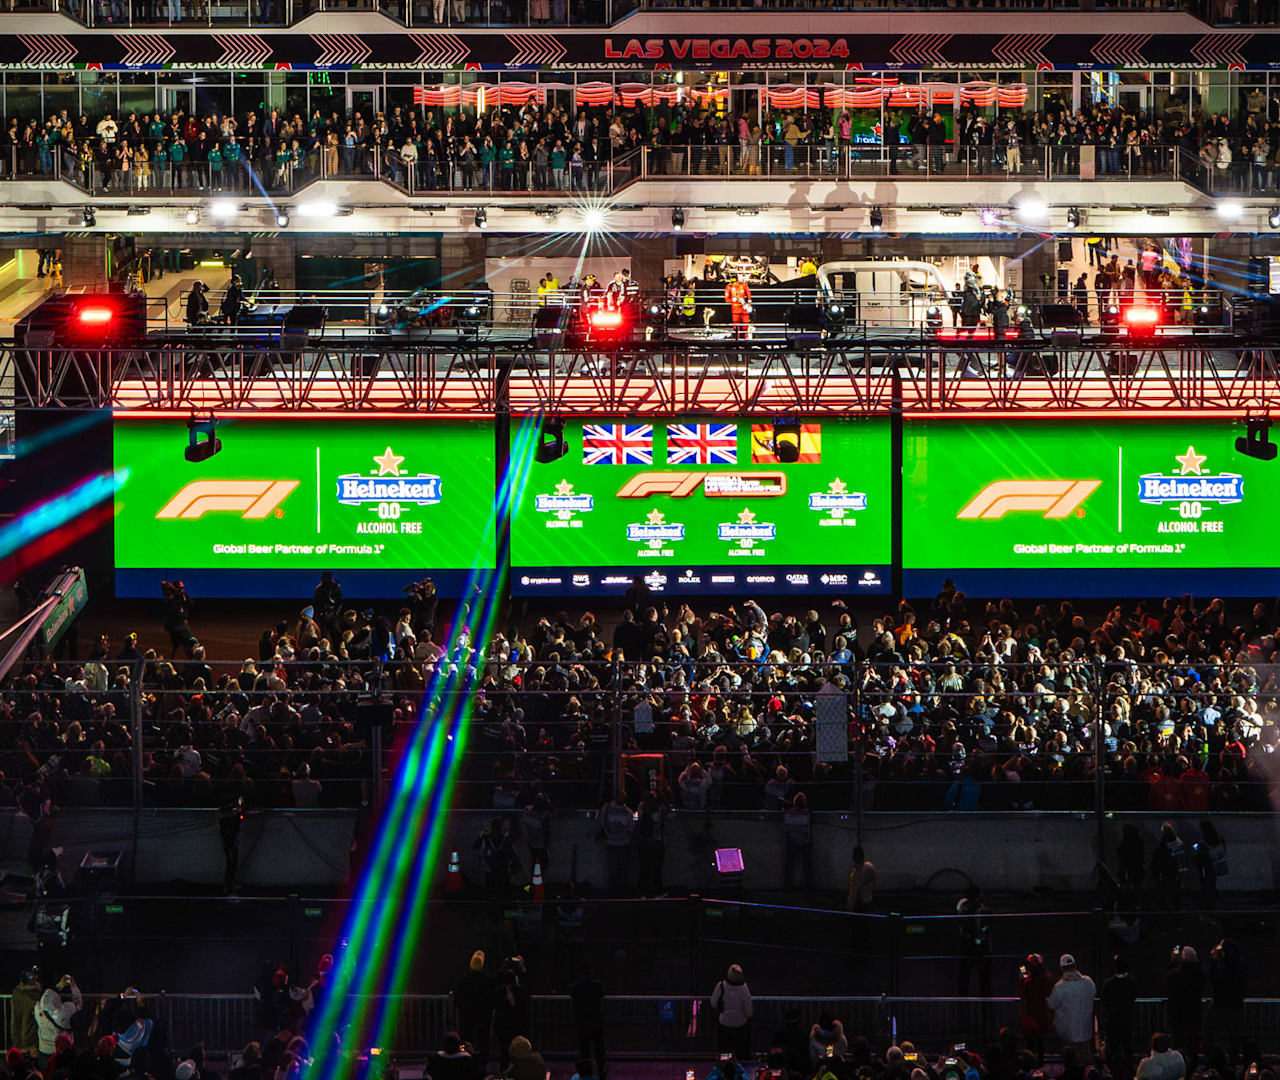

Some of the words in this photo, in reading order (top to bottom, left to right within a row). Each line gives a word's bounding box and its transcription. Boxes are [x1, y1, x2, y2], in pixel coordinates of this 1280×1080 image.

[605, 39, 664, 58] LAS
[669, 39, 772, 58] VEGAS
[775, 39, 850, 58] 2024
[155, 480, 301, 519] F1
[956, 479, 1102, 518] F1
[378, 503, 401, 519] 0.0
[1179, 502, 1202, 518] 0.0
[357, 522, 398, 534] ALCOHOL
[400, 522, 423, 534] FREE
[1158, 521, 1199, 533] ALCOHOL
[1201, 521, 1224, 533] FREE
[213, 544, 246, 554] Global
[248, 544, 273, 554] Beer
[275, 544, 313, 554] Partner
[315, 544, 328, 554] of
[329, 544, 372, 554] Formula
[1014, 543, 1047, 553] Global
[1049, 543, 1074, 553] Beer
[1076, 543, 1114, 553] Partner
[1116, 543, 1129, 553] of
[1130, 543, 1173, 553] Formula
[573, 575, 590, 583] aws
